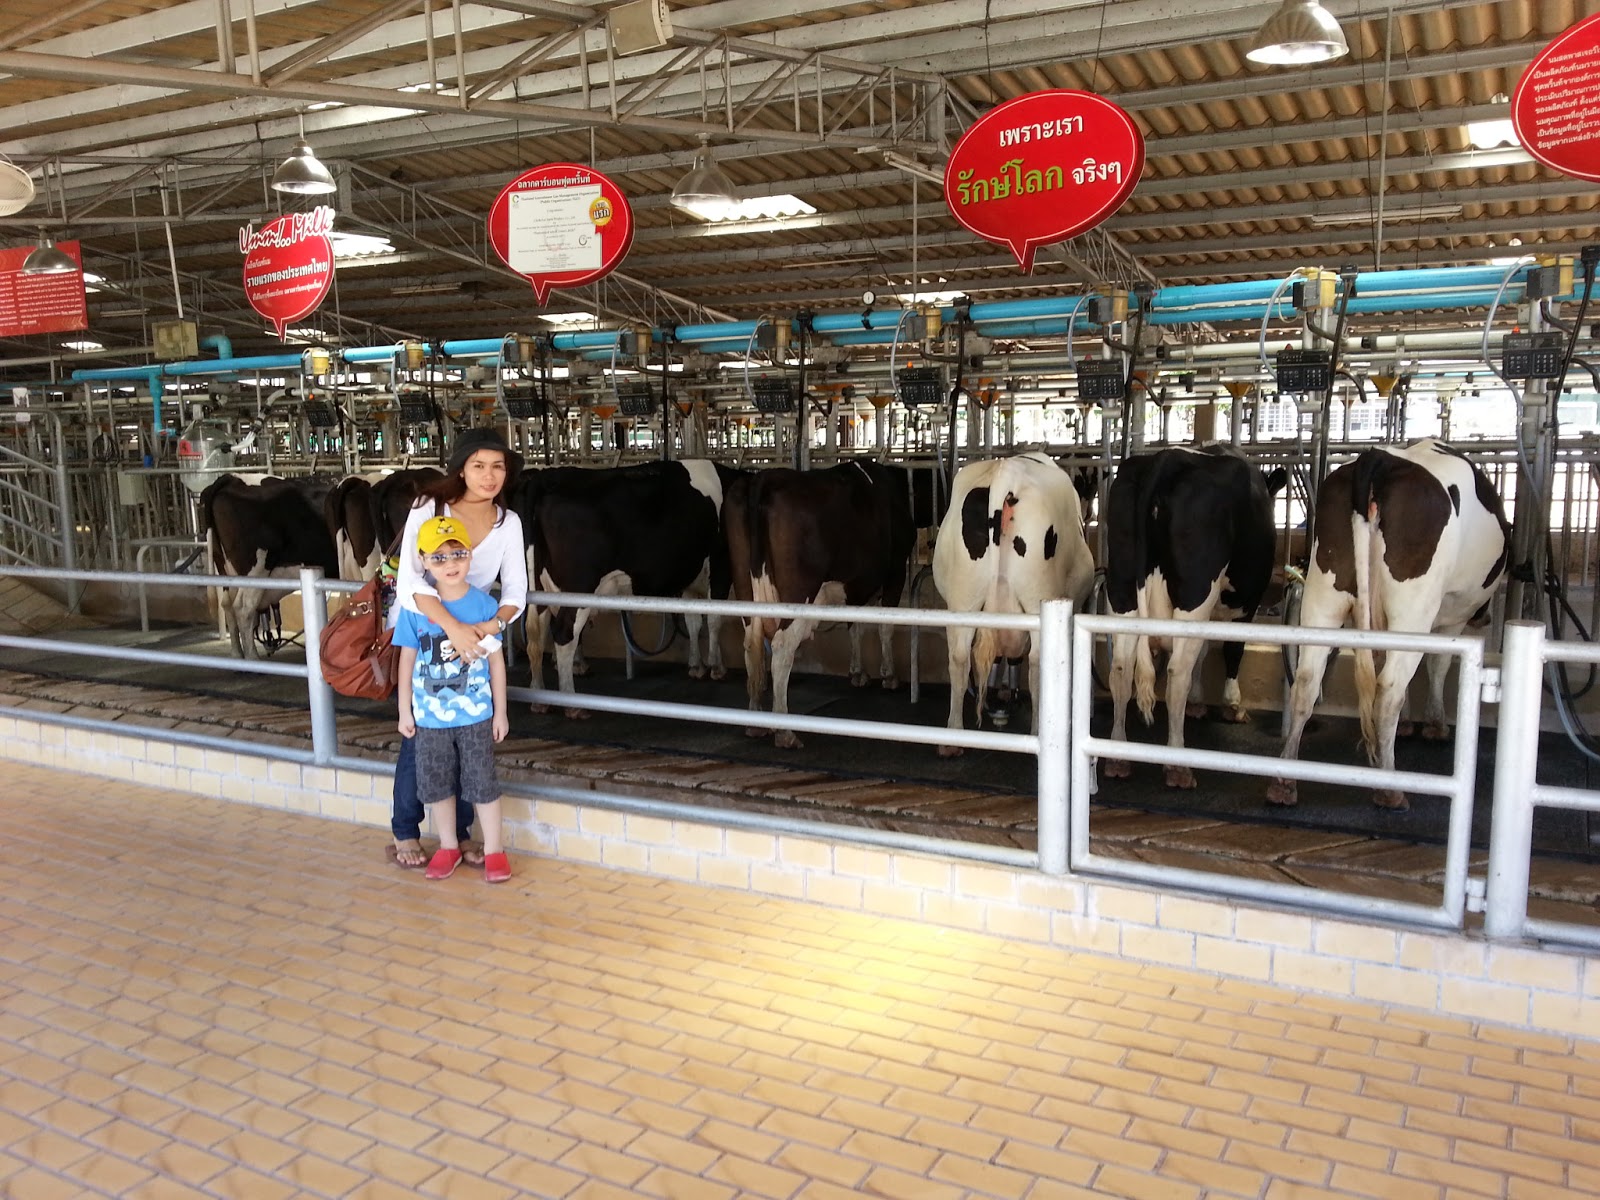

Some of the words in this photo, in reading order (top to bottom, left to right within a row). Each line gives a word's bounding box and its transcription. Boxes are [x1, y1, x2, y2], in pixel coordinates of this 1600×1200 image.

[999, 115, 1083, 147] เพราะเรา
[957, 158, 1063, 205] รักษ์โลก
[1071, 157, 1122, 185] จริงๆ
